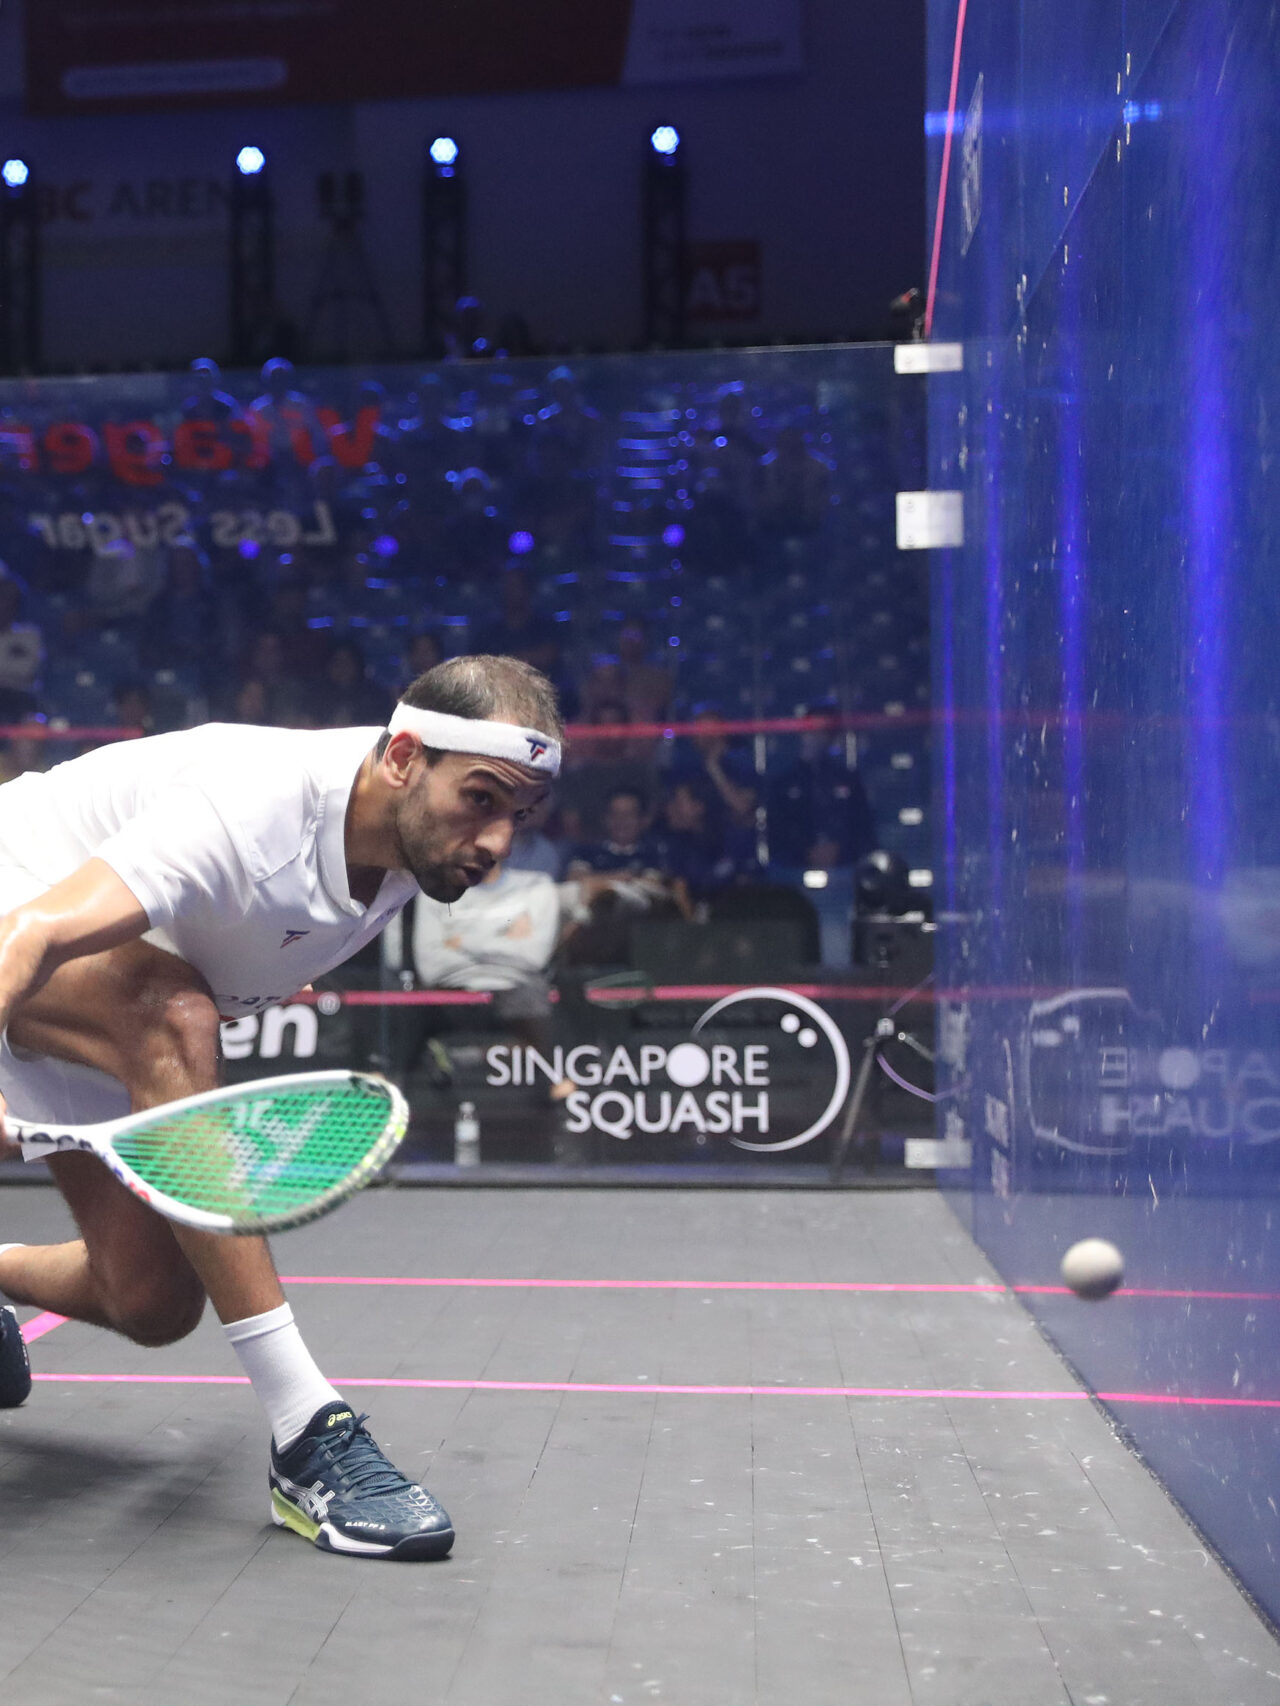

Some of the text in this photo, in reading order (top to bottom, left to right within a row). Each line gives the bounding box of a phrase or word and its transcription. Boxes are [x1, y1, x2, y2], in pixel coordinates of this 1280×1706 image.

[107, 177, 232, 221] AREN
[485, 1042, 770, 1087] SINGAPORE
[565, 1090, 770, 1140] SQUASH
